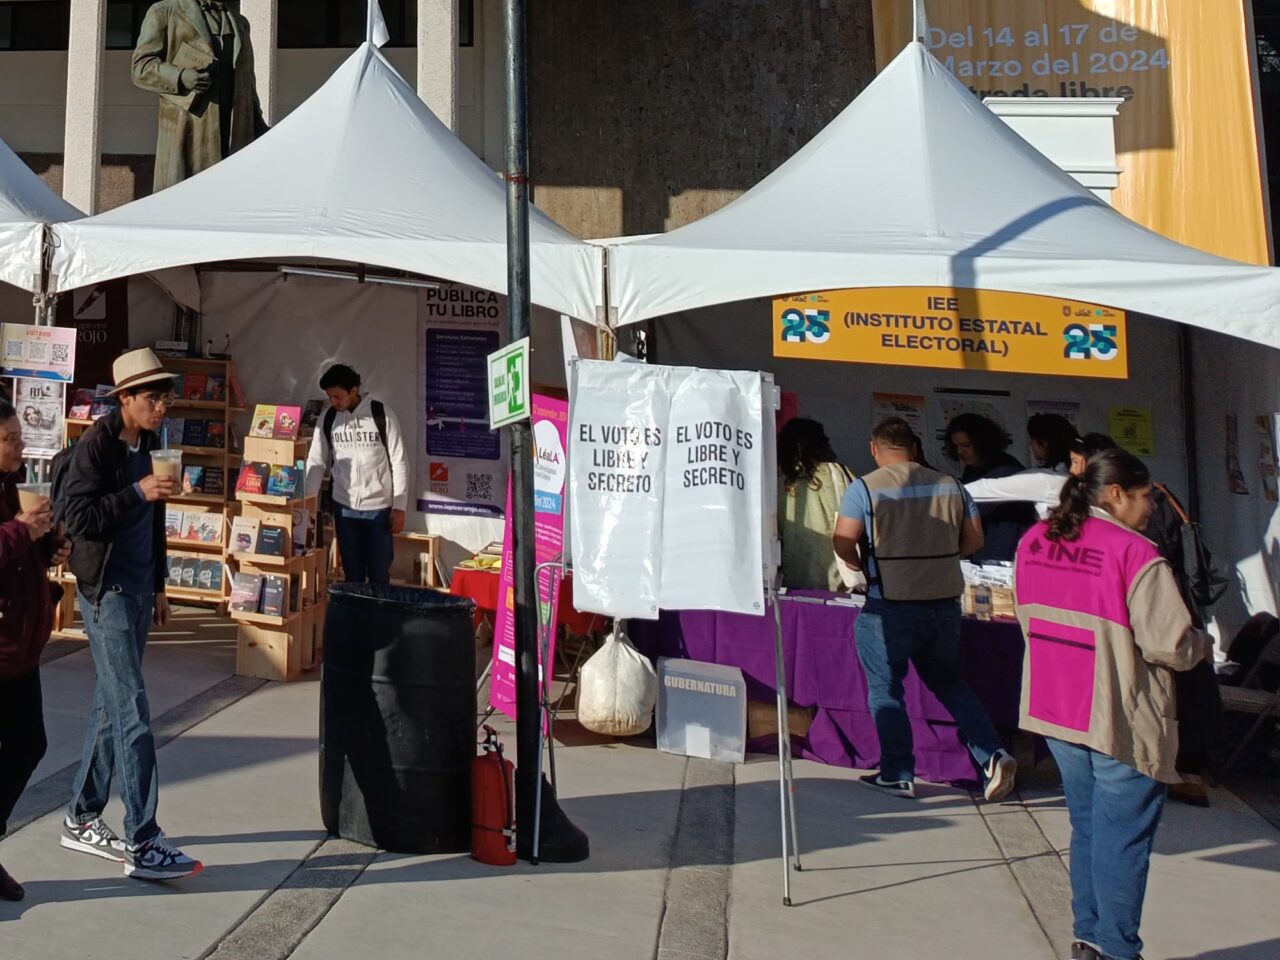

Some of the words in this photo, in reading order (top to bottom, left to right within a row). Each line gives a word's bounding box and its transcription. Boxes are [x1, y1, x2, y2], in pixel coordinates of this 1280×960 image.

[926, 23, 973, 49] Del
[982, 26, 1015, 48] 14
[1024, 23, 1049, 47] al
[1058, 24, 1089, 46] 17
[1099, 20, 1139, 43] de
[1031, 52, 1079, 76] del
[1088, 48, 1170, 74] 2024
[426, 304, 447, 316] TU
[452, 304, 499, 318] LIBRO
[927, 296, 959, 311] IEE
[844, 312, 953, 331] (INSTITUTO
[959, 319, 1048, 336] ESTATAL
[881, 334, 1009, 358] ELECTORAL)
[579, 424, 596, 442] EL
[601, 425, 640, 445] VOTO
[645, 427, 661, 446] ES
[677, 426, 691, 443] EL
[695, 421, 732, 442] VOTO
[736, 429, 753, 449] ES
[593, 449, 635, 469] LIBRE
[641, 451, 648, 469] Y
[688, 444, 727, 464] LIBRE
[732, 448, 740, 466] Y
[588, 472, 651, 493] SECRETO
[683, 466, 745, 491] SECRETO
[1048, 543, 1104, 568] INE
[664, 675, 736, 697] GUBERNATURA
